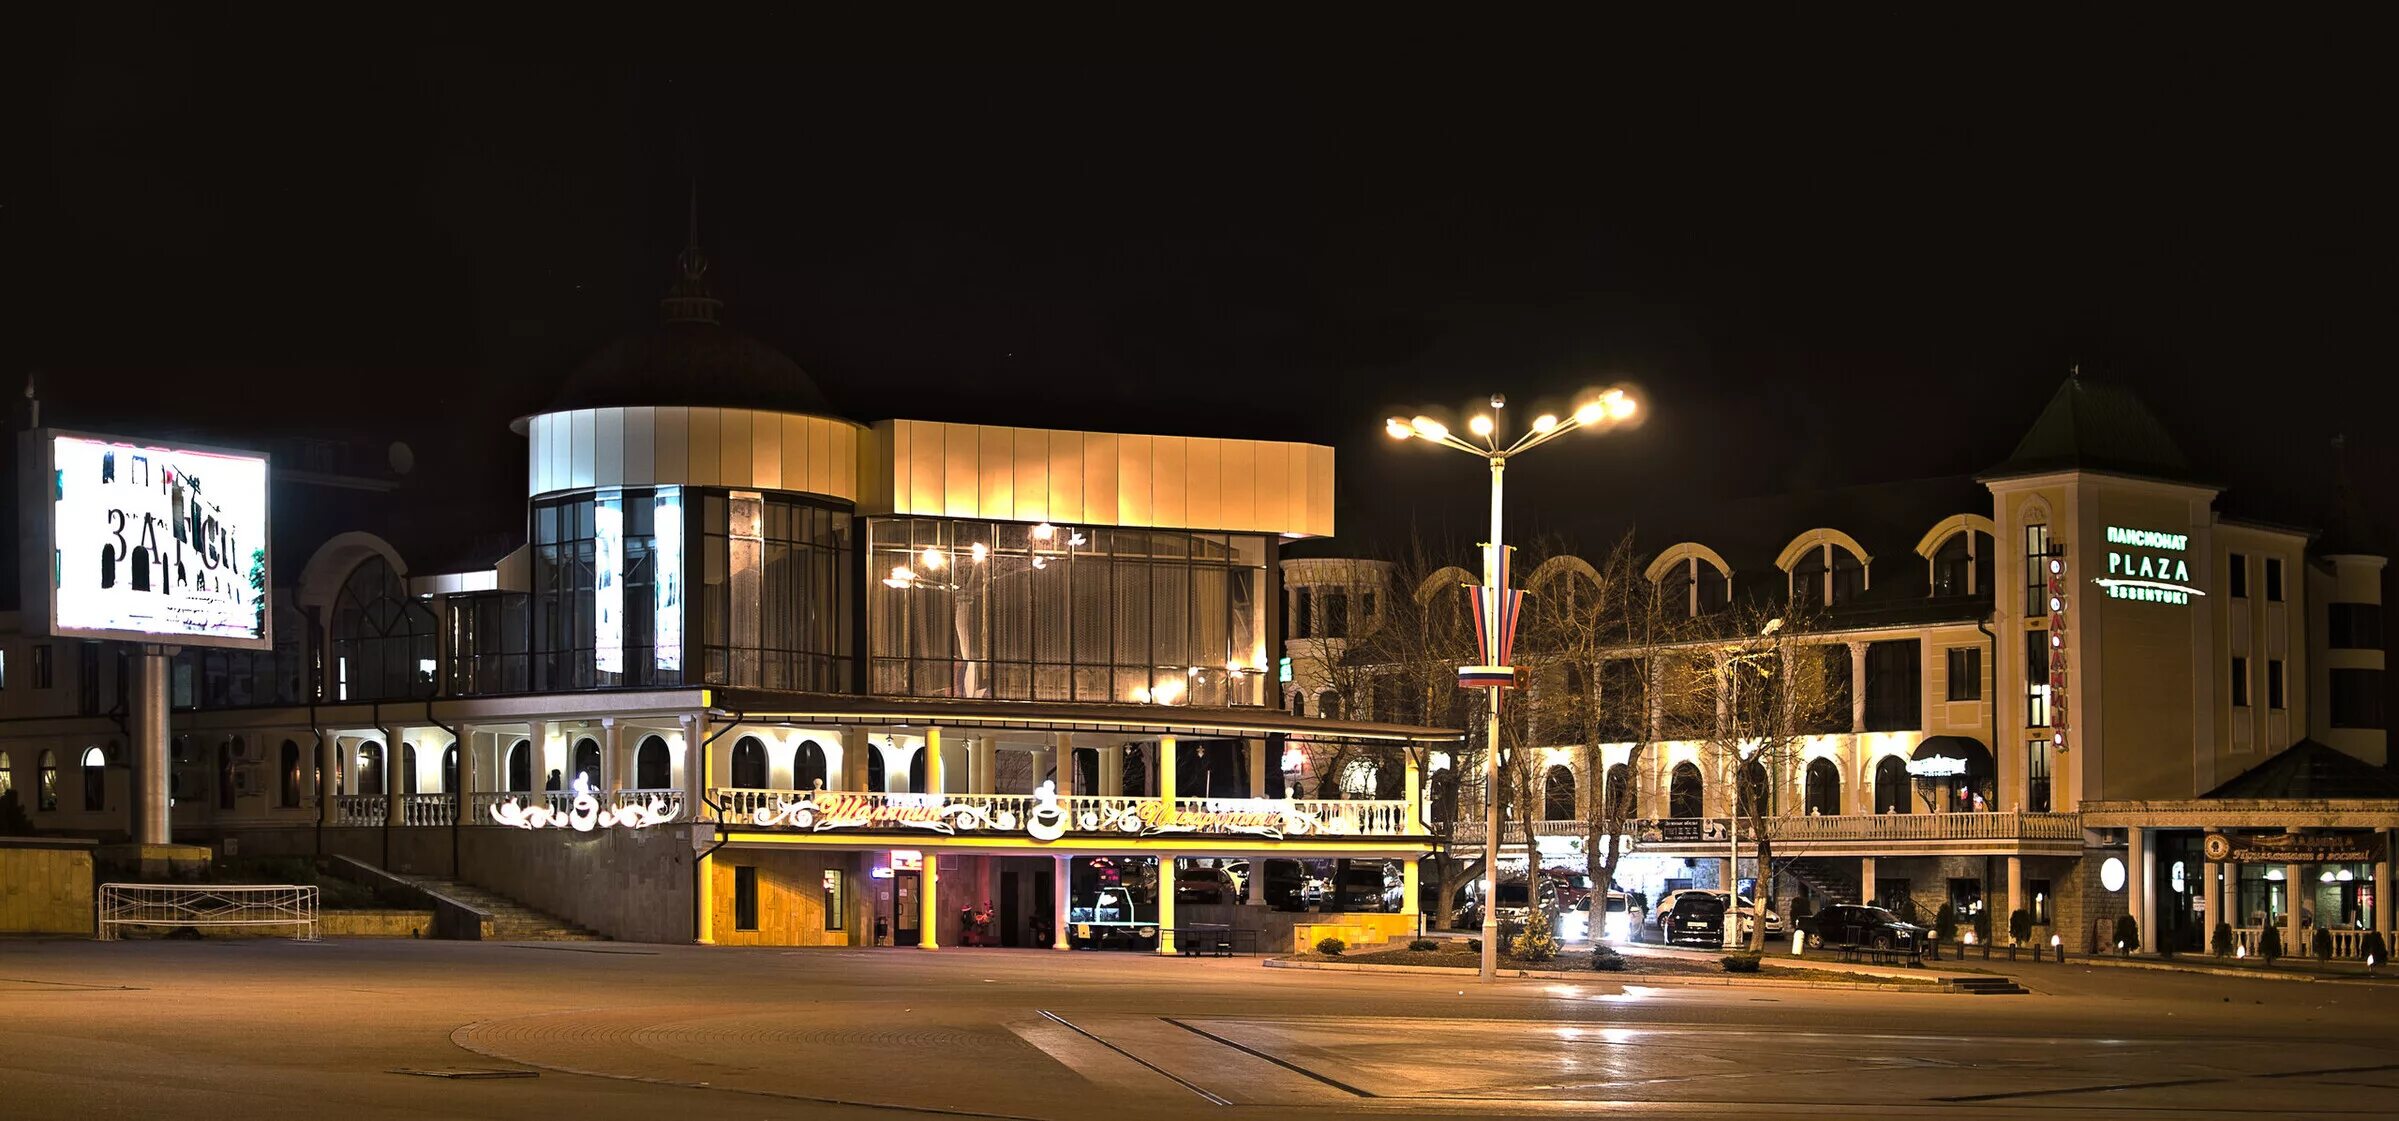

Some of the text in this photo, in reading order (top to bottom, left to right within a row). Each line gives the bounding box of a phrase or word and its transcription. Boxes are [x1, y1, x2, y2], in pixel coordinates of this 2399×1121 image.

[2106, 526, 2188, 551] ПАНСИОНАТ
[2108, 552, 2189, 582] PLAZA
[2108, 585, 2188, 605] ESSENTUKI
